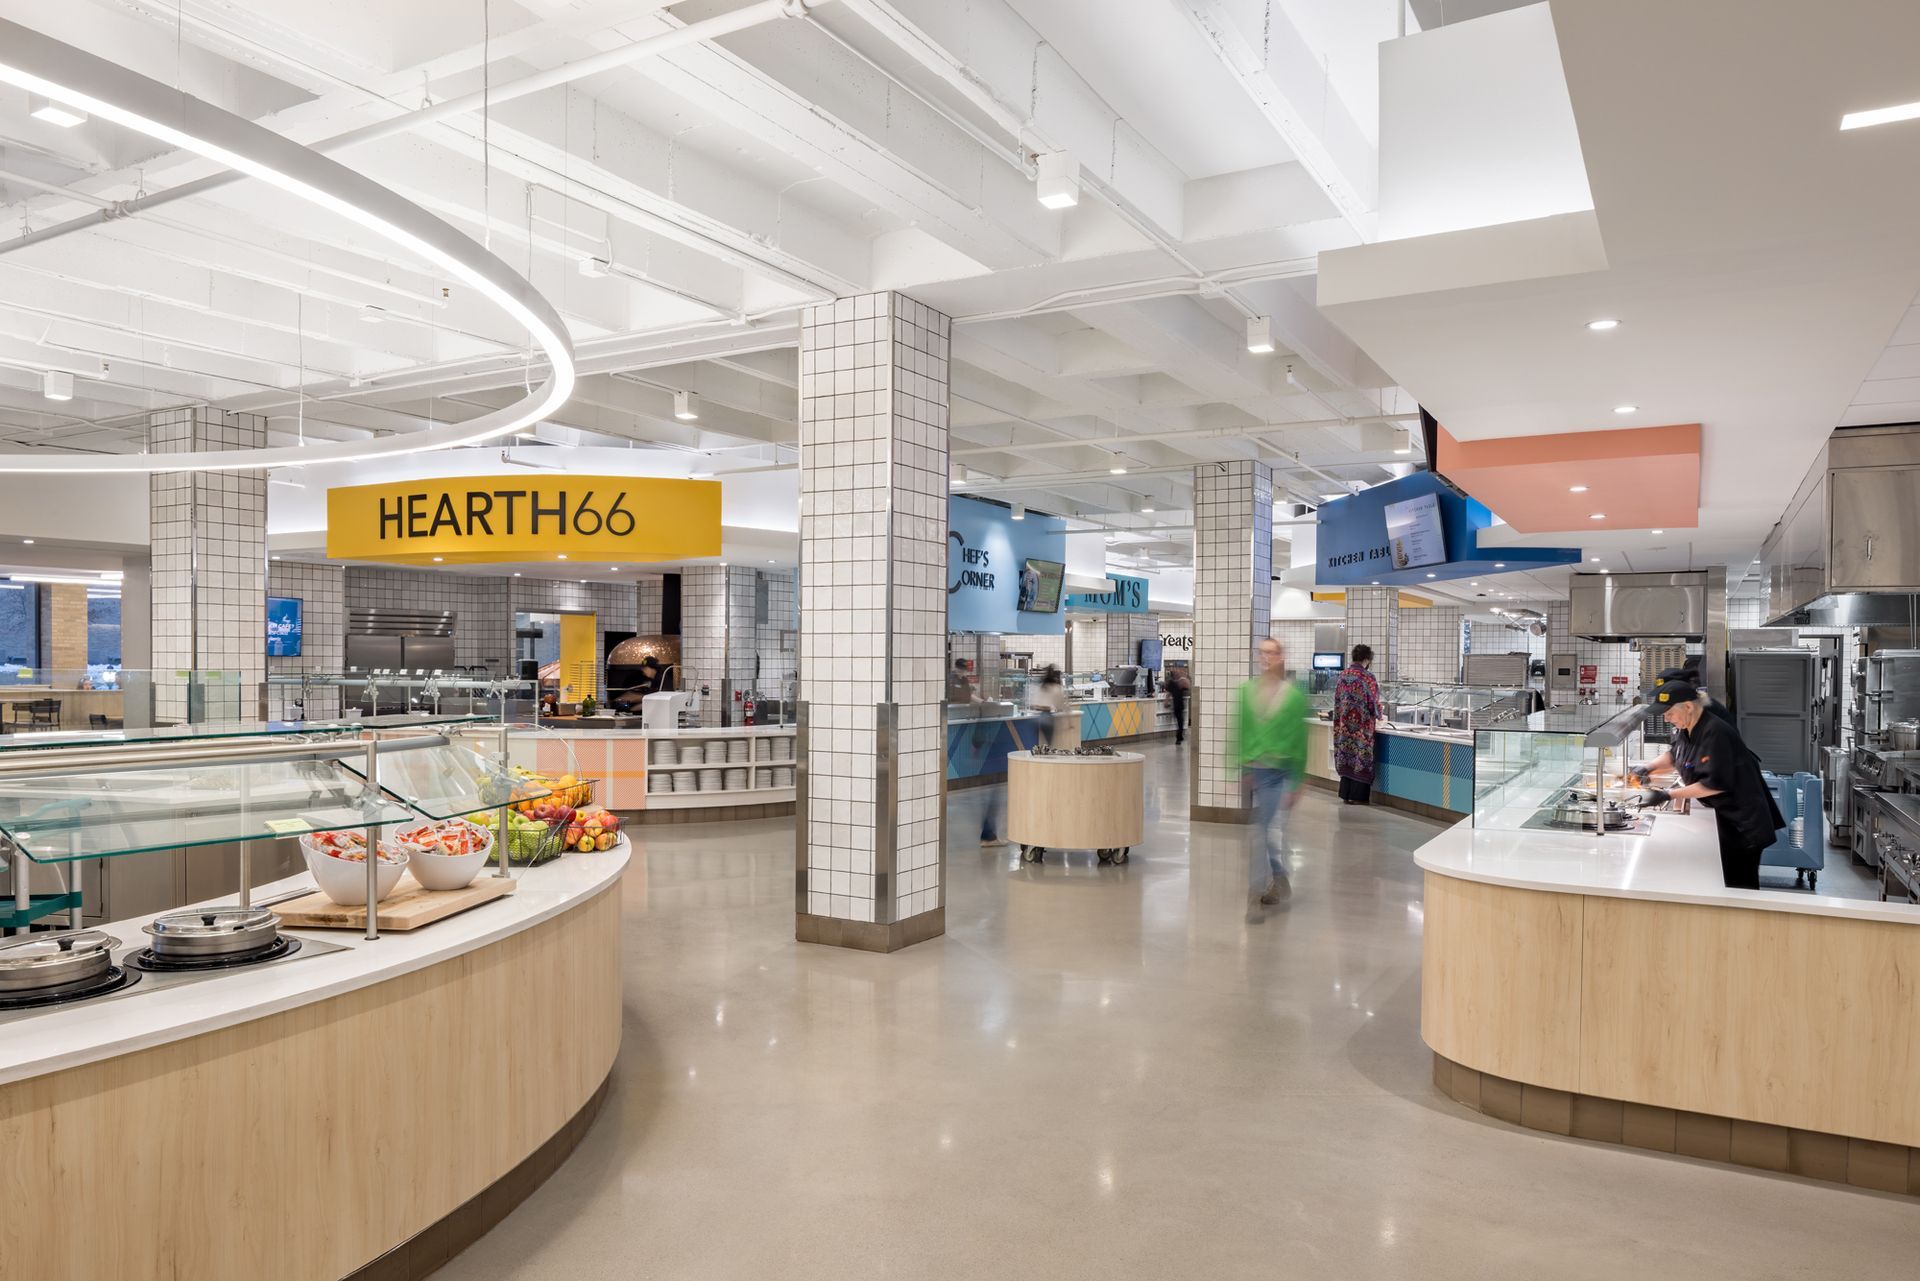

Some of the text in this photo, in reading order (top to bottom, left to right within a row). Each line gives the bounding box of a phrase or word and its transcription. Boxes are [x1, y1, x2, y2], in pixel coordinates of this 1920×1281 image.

[379, 490, 636, 540] HEARTH66
[1328, 546, 1392, 568] KITCHEN TABL
[1159, 634, 1193, 651] reats
